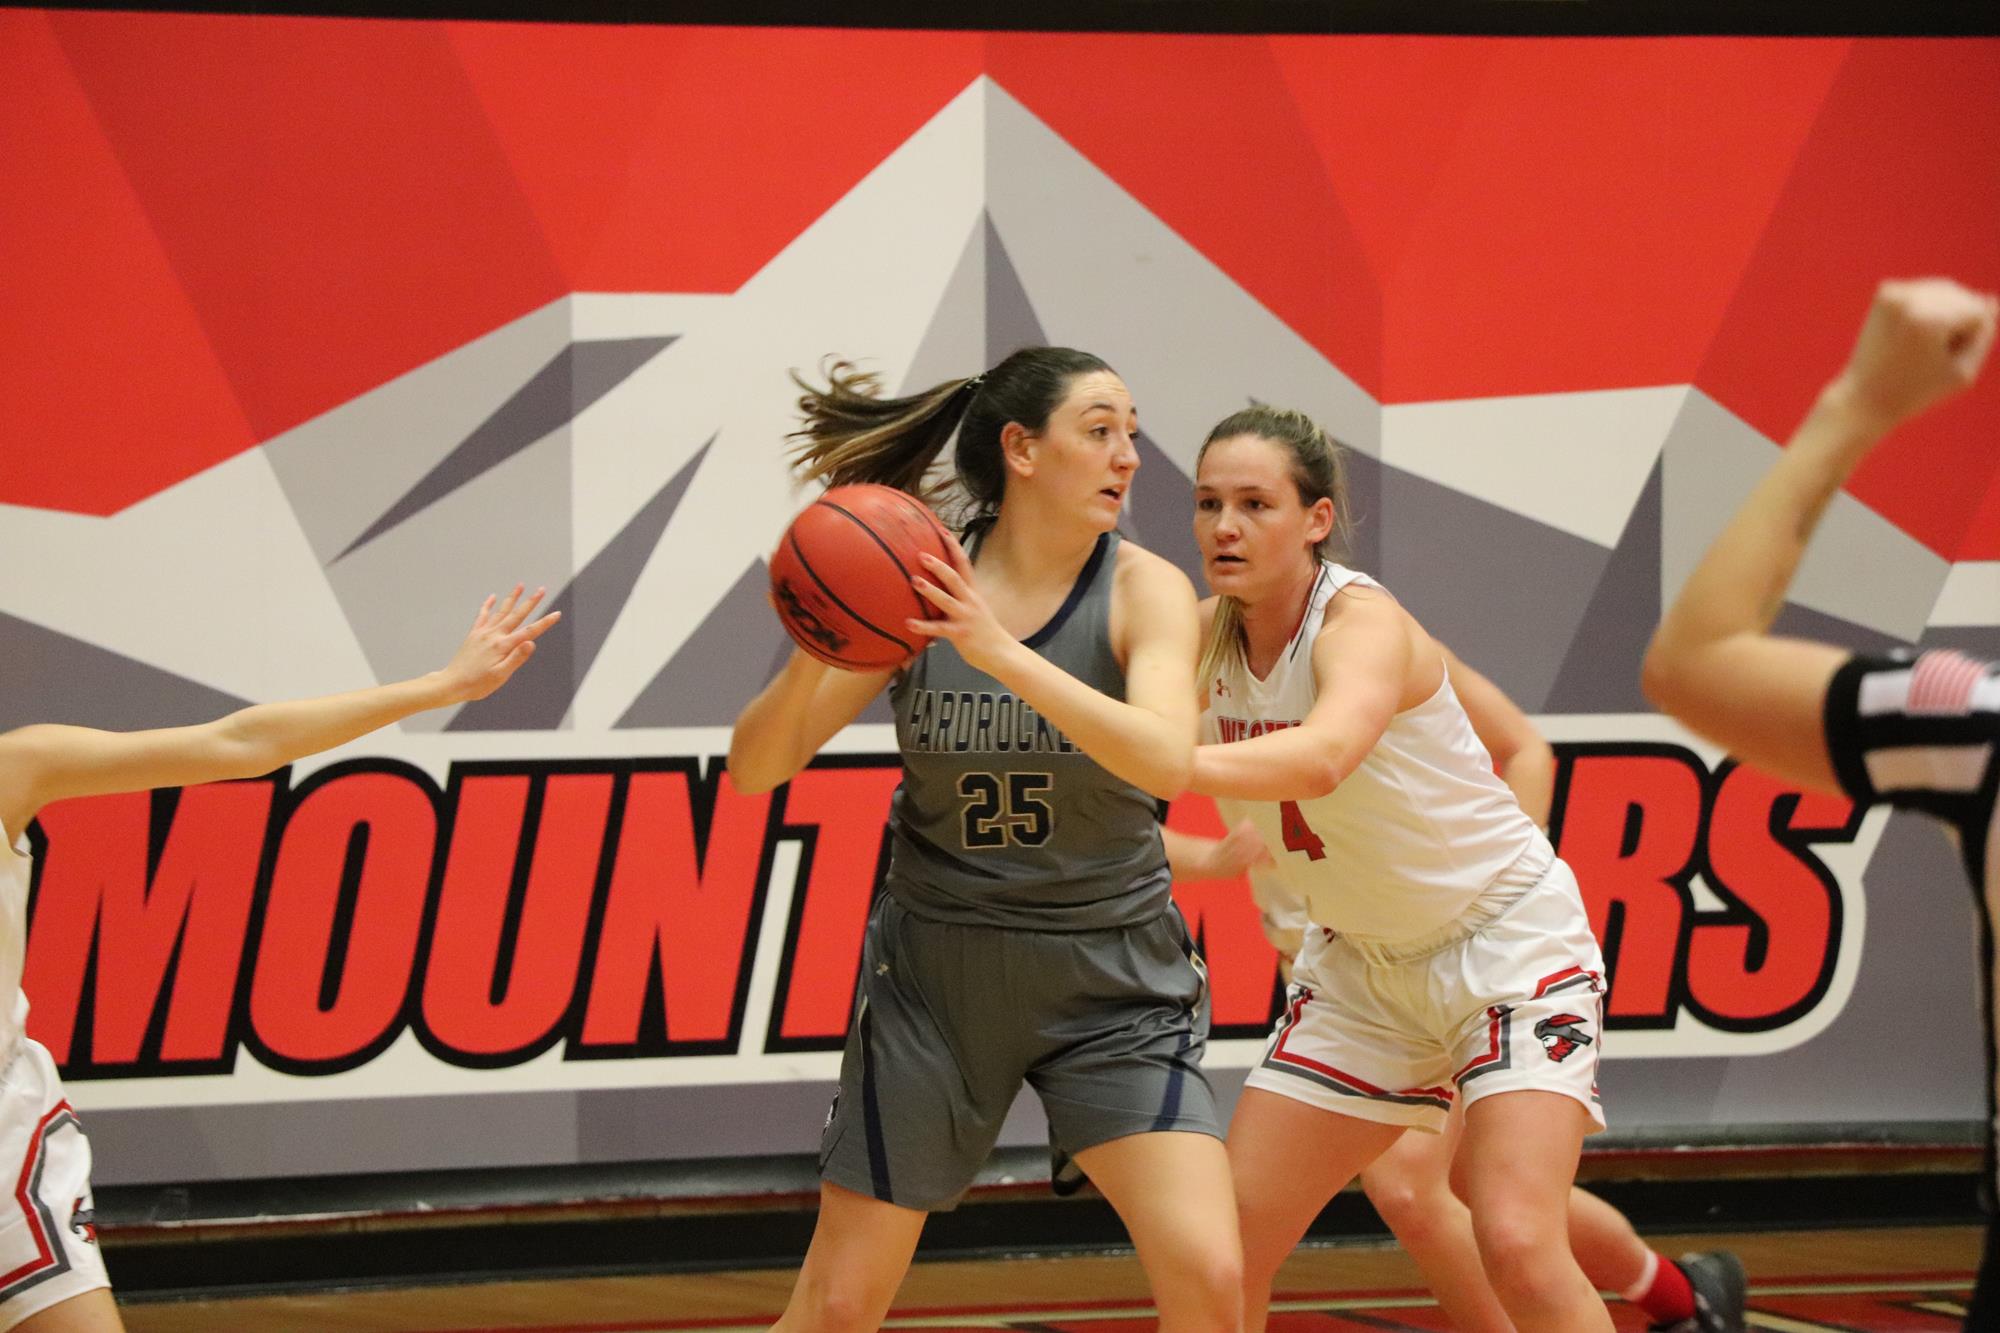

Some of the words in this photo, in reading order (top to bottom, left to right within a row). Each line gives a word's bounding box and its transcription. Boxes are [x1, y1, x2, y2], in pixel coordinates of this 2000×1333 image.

[905, 688, 1084, 754] HARDROCK
[956, 771, 1054, 849] 25
[1279, 800, 1327, 862] 4
[22, 747, 1862, 1076] MOUNTRS
